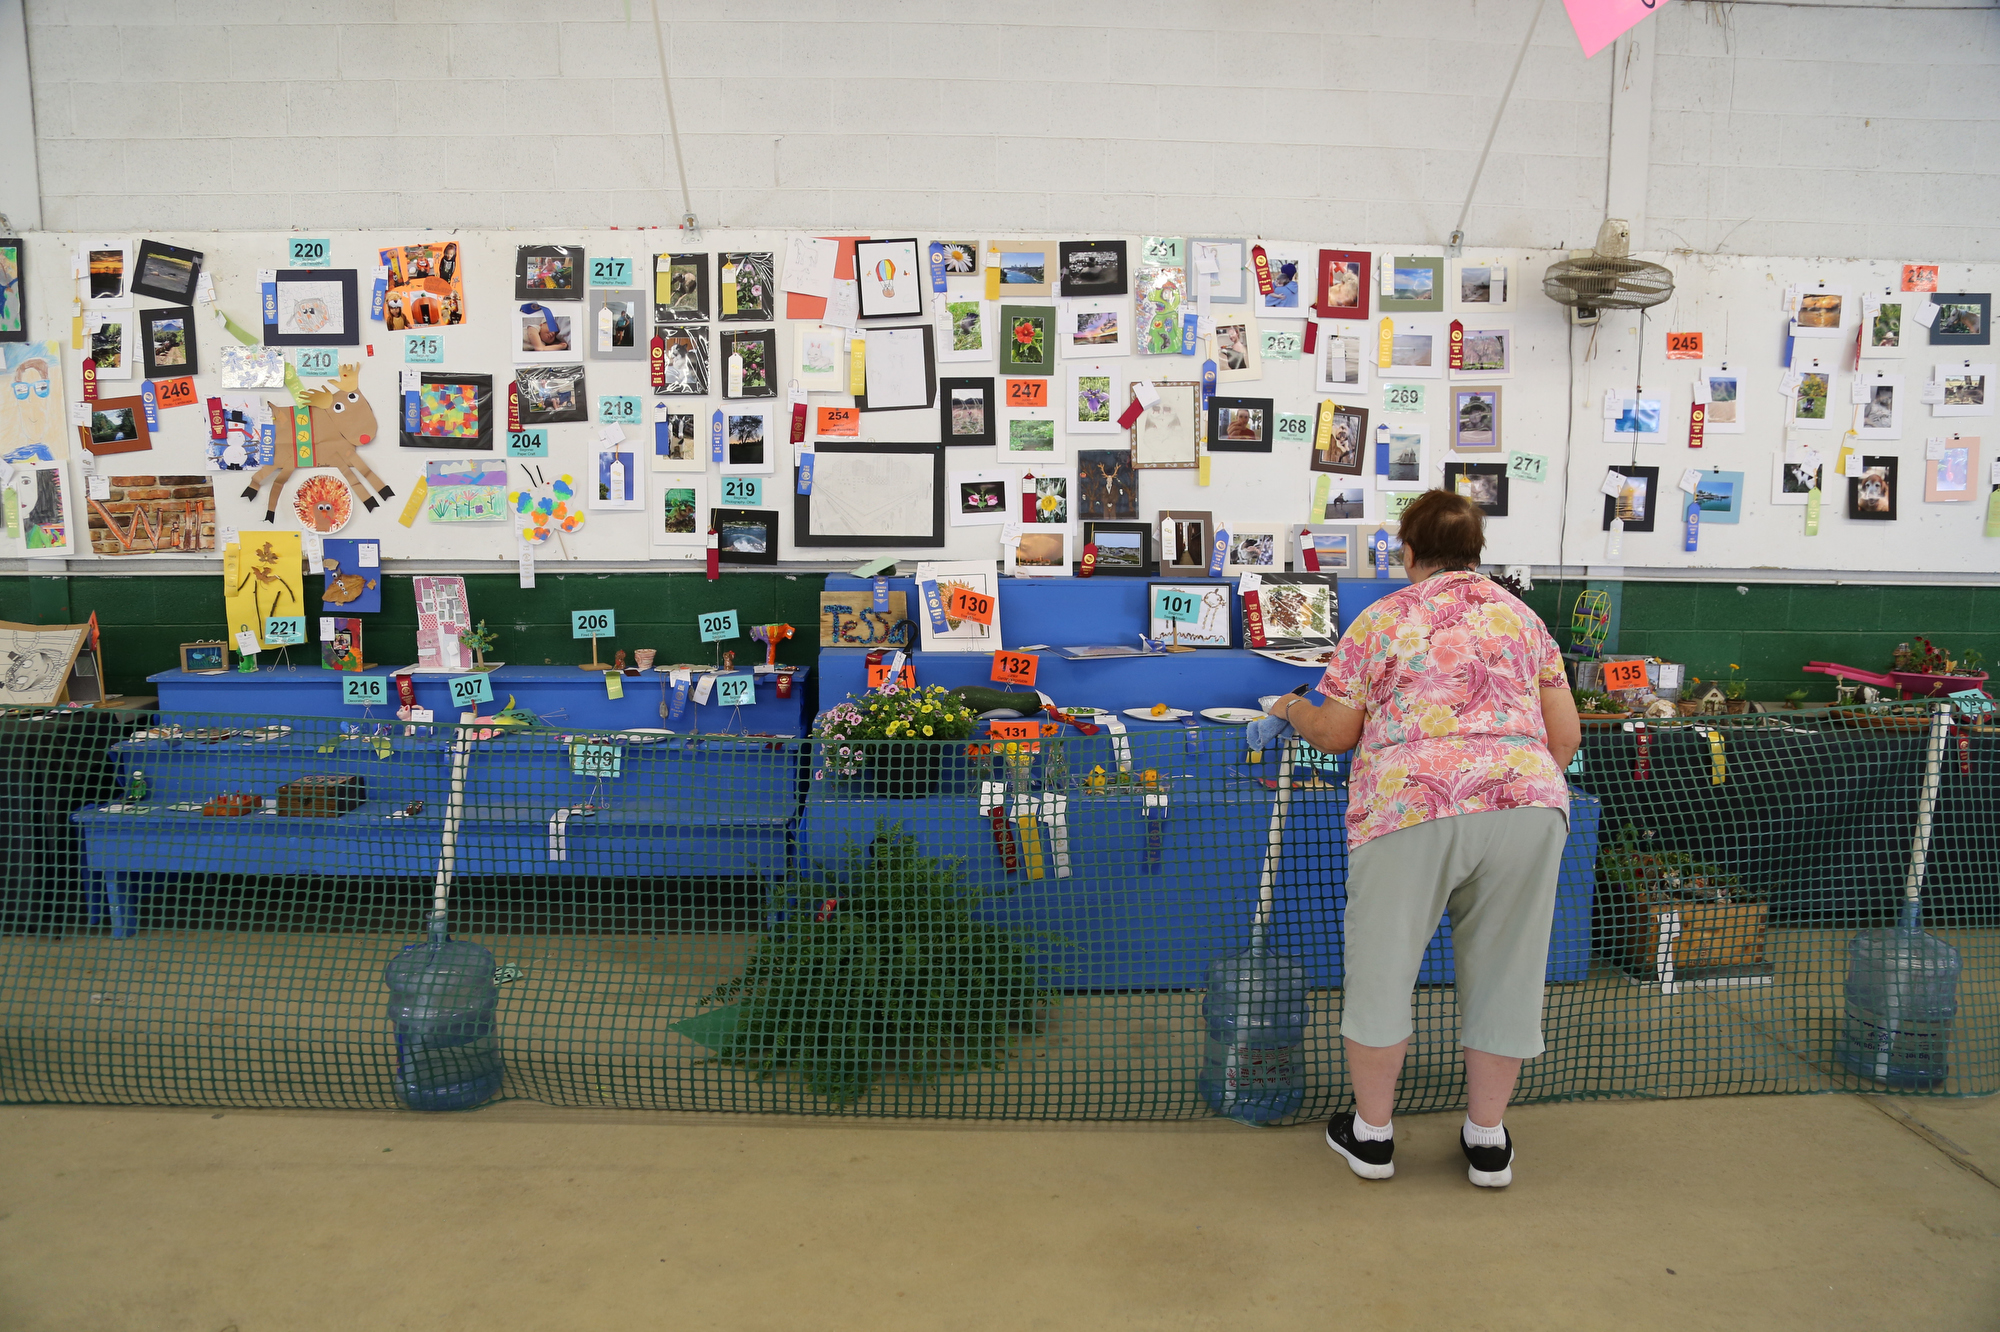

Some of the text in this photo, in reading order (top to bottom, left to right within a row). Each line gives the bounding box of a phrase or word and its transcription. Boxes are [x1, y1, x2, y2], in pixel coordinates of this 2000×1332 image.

[294, 243, 323, 257] 220
[595, 262, 624, 277] 217
[1907, 269, 1933, 283] 244
[409, 340, 437, 354] 215
[1267, 336, 1294, 351] 267
[1672, 337, 1698, 350] 245
[302, 353, 331, 367] 210
[160, 382, 190, 399] 246
[1012, 383, 1041, 398] 247
[1391, 389, 1418, 403] 269
[603, 401, 633, 415] 218
[828, 411, 849, 420] 254
[1279, 419, 1306, 433] 268
[512, 434, 541, 448] 204
[1513, 456, 1541, 473] 271
[726, 482, 755, 496] 219
[85, 487, 203, 549] Will
[959, 594, 988, 614] 130
[1162, 596, 1192, 613] 101
[270, 621, 296, 635] 221
[578, 614, 608, 630] 206
[704, 616, 732, 633] 205
[1000, 656, 1030, 675] 132
[1612, 665, 1641, 681] 135
[348, 681, 380, 695] 216
[454, 679, 482, 697] 207
[722, 680, 747, 696] 212
[1004, 727, 1026, 737] 131
